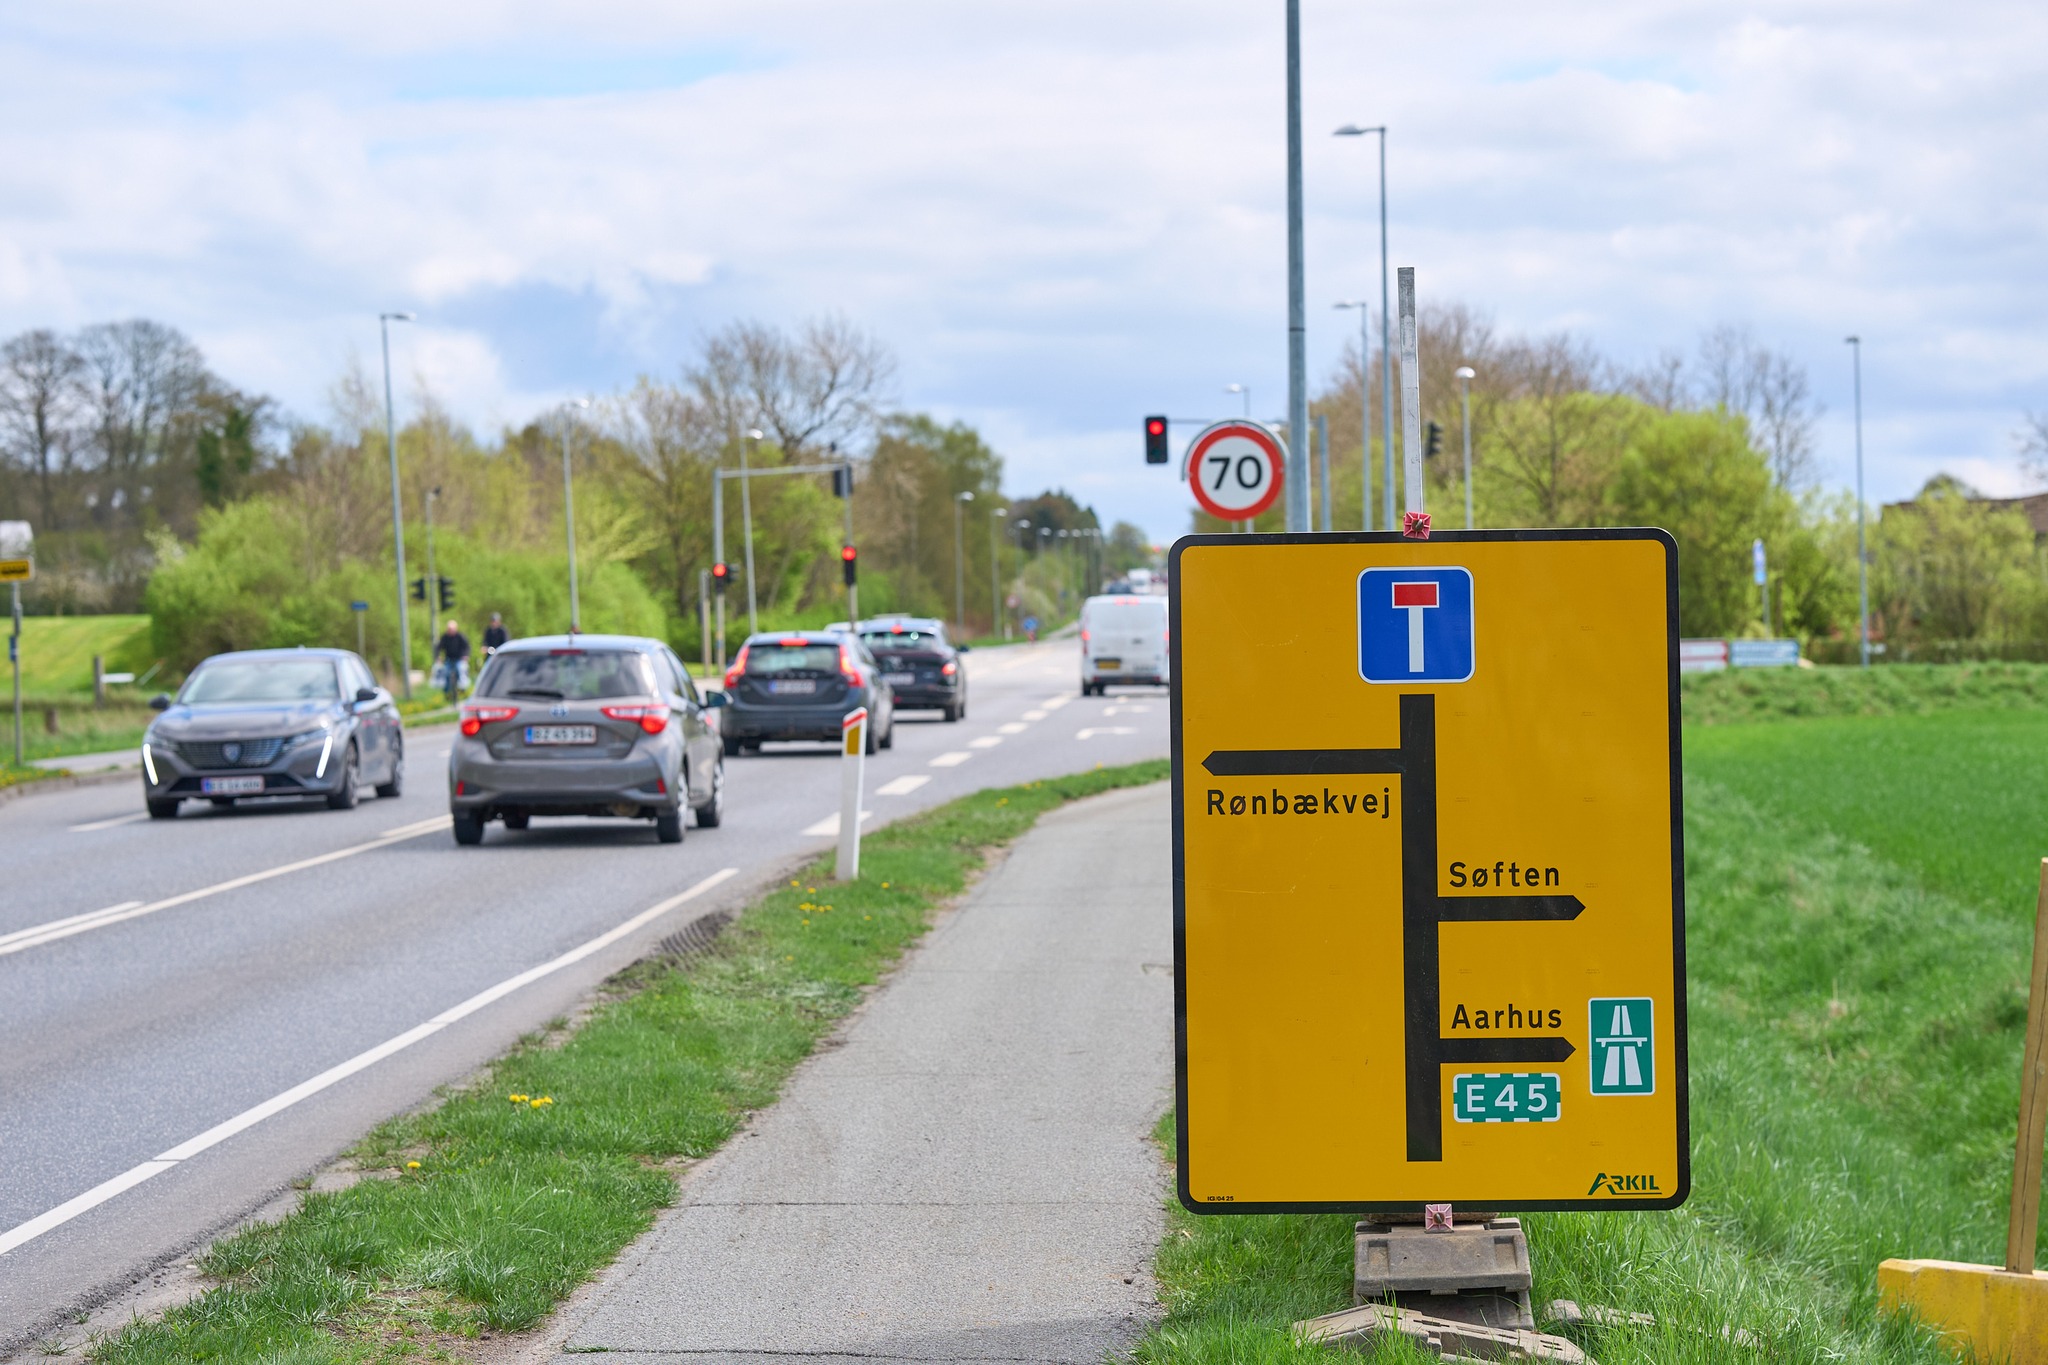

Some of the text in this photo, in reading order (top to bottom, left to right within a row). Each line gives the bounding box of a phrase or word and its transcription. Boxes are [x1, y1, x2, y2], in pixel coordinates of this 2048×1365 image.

[1209, 456, 1262, 489] 70
[1207, 788, 1390, 819] Rønbækvej
[1449, 861, 1559, 888] Søften
[1451, 1003, 1562, 1030] Aarhus
[1587, 1172, 1660, 1196] ARKIL
